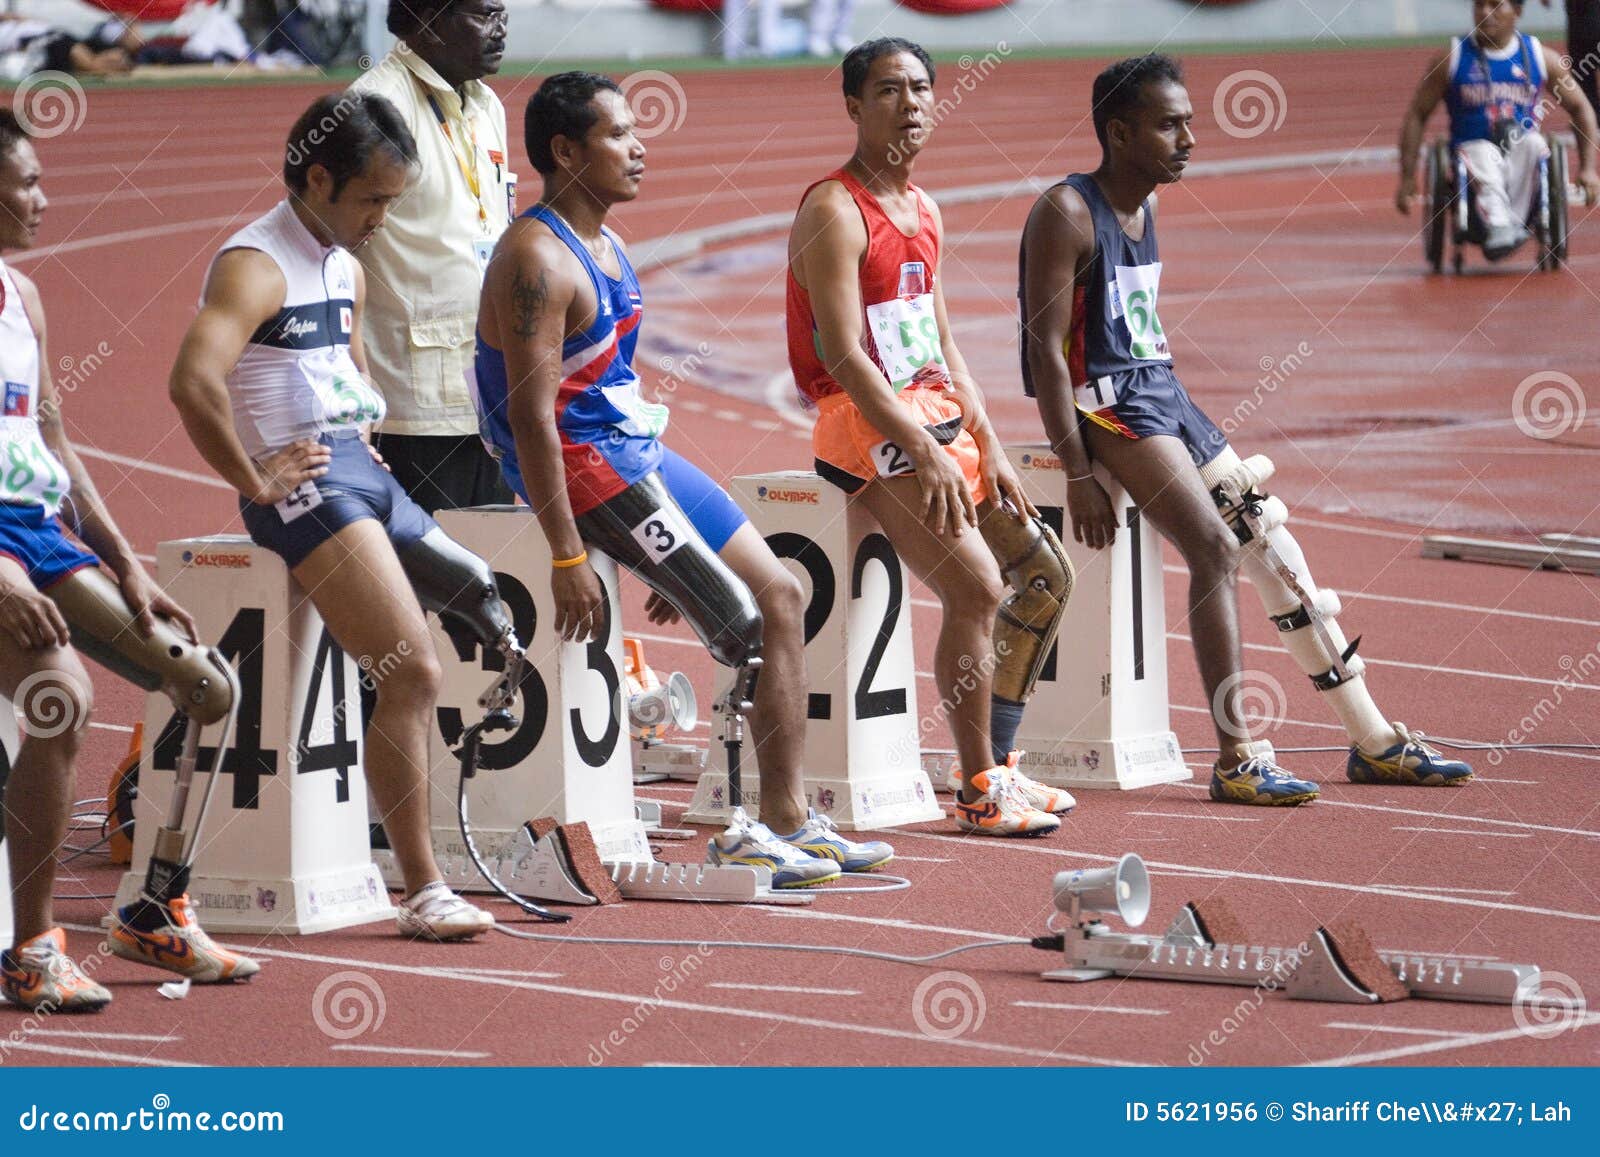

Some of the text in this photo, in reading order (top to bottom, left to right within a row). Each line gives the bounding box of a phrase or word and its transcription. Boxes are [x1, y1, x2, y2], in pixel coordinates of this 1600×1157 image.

[279, 316, 318, 340] Japan
[768, 489, 819, 504] OLYMPIC
[881, 442, 910, 473] 2
[195, 554, 252, 568] OLYMPIC
[645, 520, 675, 552] 3
[852, 533, 907, 720] 2
[1127, 506, 1145, 681] 1
[153, 607, 278, 810] 4
[297, 622, 358, 804] 4
[569, 574, 622, 768] 3
